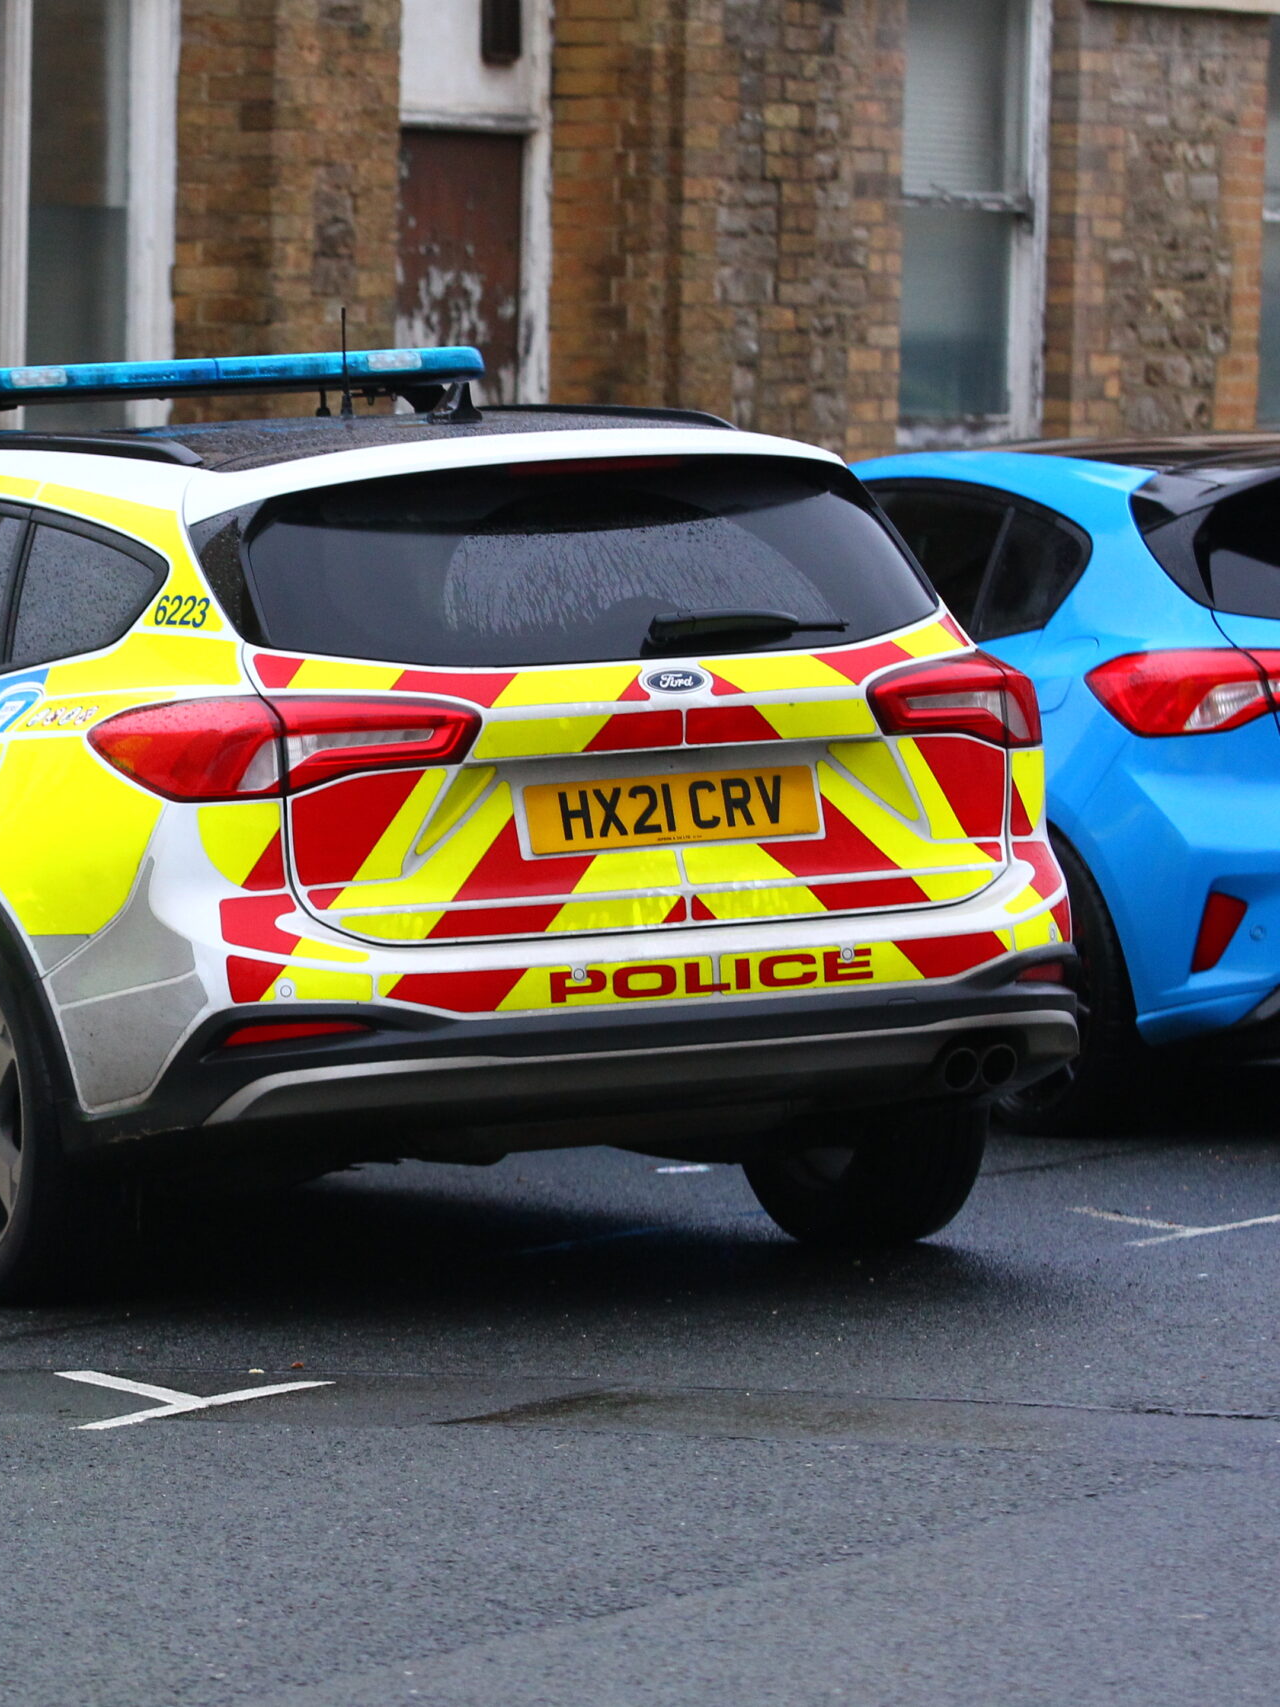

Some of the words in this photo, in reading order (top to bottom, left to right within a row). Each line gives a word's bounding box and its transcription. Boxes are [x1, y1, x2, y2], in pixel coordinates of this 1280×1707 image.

[154, 595, 210, 628] 6223
[660, 673, 693, 688] Ford
[558, 783, 676, 841] HX21
[688, 775, 781, 829] CRV
[549, 948, 873, 1004] POLICE
